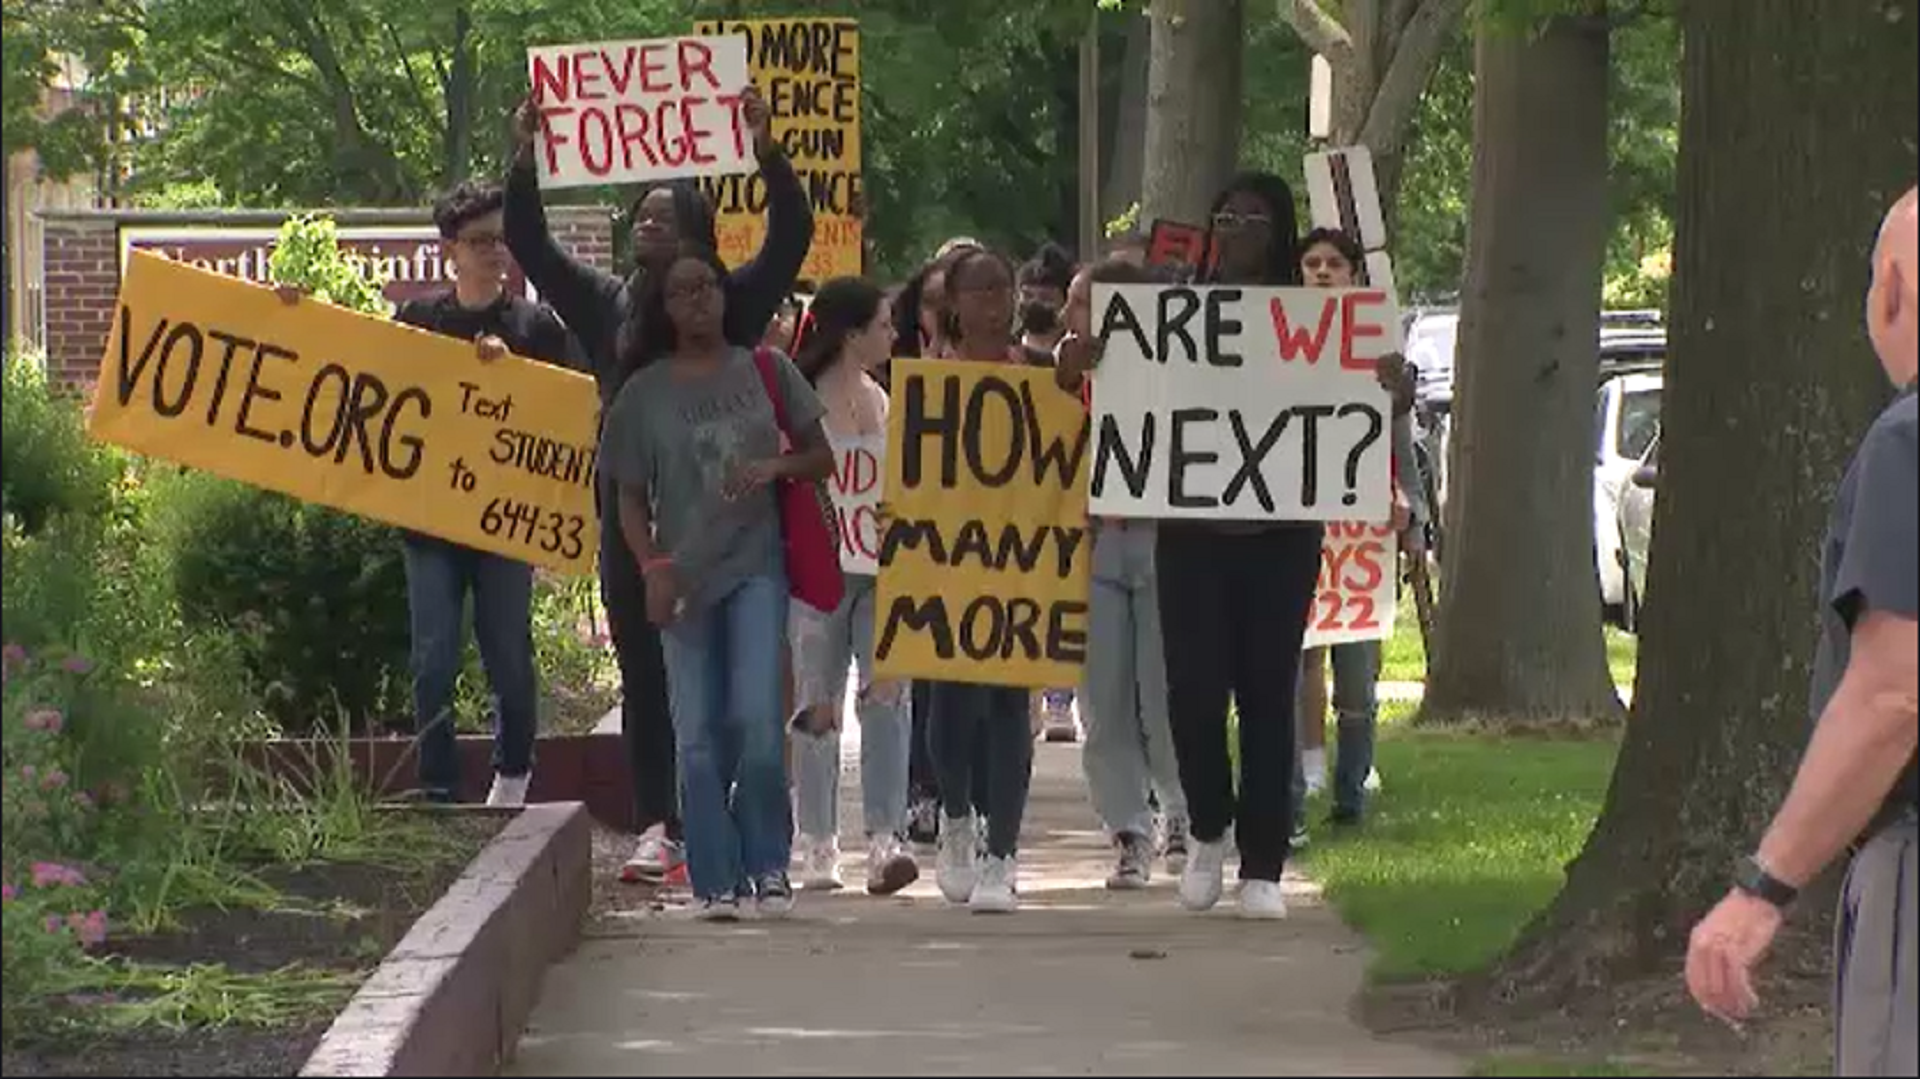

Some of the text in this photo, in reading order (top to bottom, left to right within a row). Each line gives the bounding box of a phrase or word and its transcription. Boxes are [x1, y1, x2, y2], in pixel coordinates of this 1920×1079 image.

[532, 40, 721, 104] NEVER
[759, 21, 856, 81] MORE
[539, 96, 744, 177] FORGET
[783, 128, 843, 161] GUN
[1098, 288, 1387, 370] ARE WE
[116, 304, 432, 480] VOTE.ORG
[458, 381, 515, 422] Text
[902, 374, 1091, 491] HOW
[1090, 402, 1382, 513] NEXT?
[449, 457, 476, 492] to
[480, 498, 585, 560] 644-33
[877, 518, 1084, 579] MANY
[874, 595, 1089, 665] MORE
